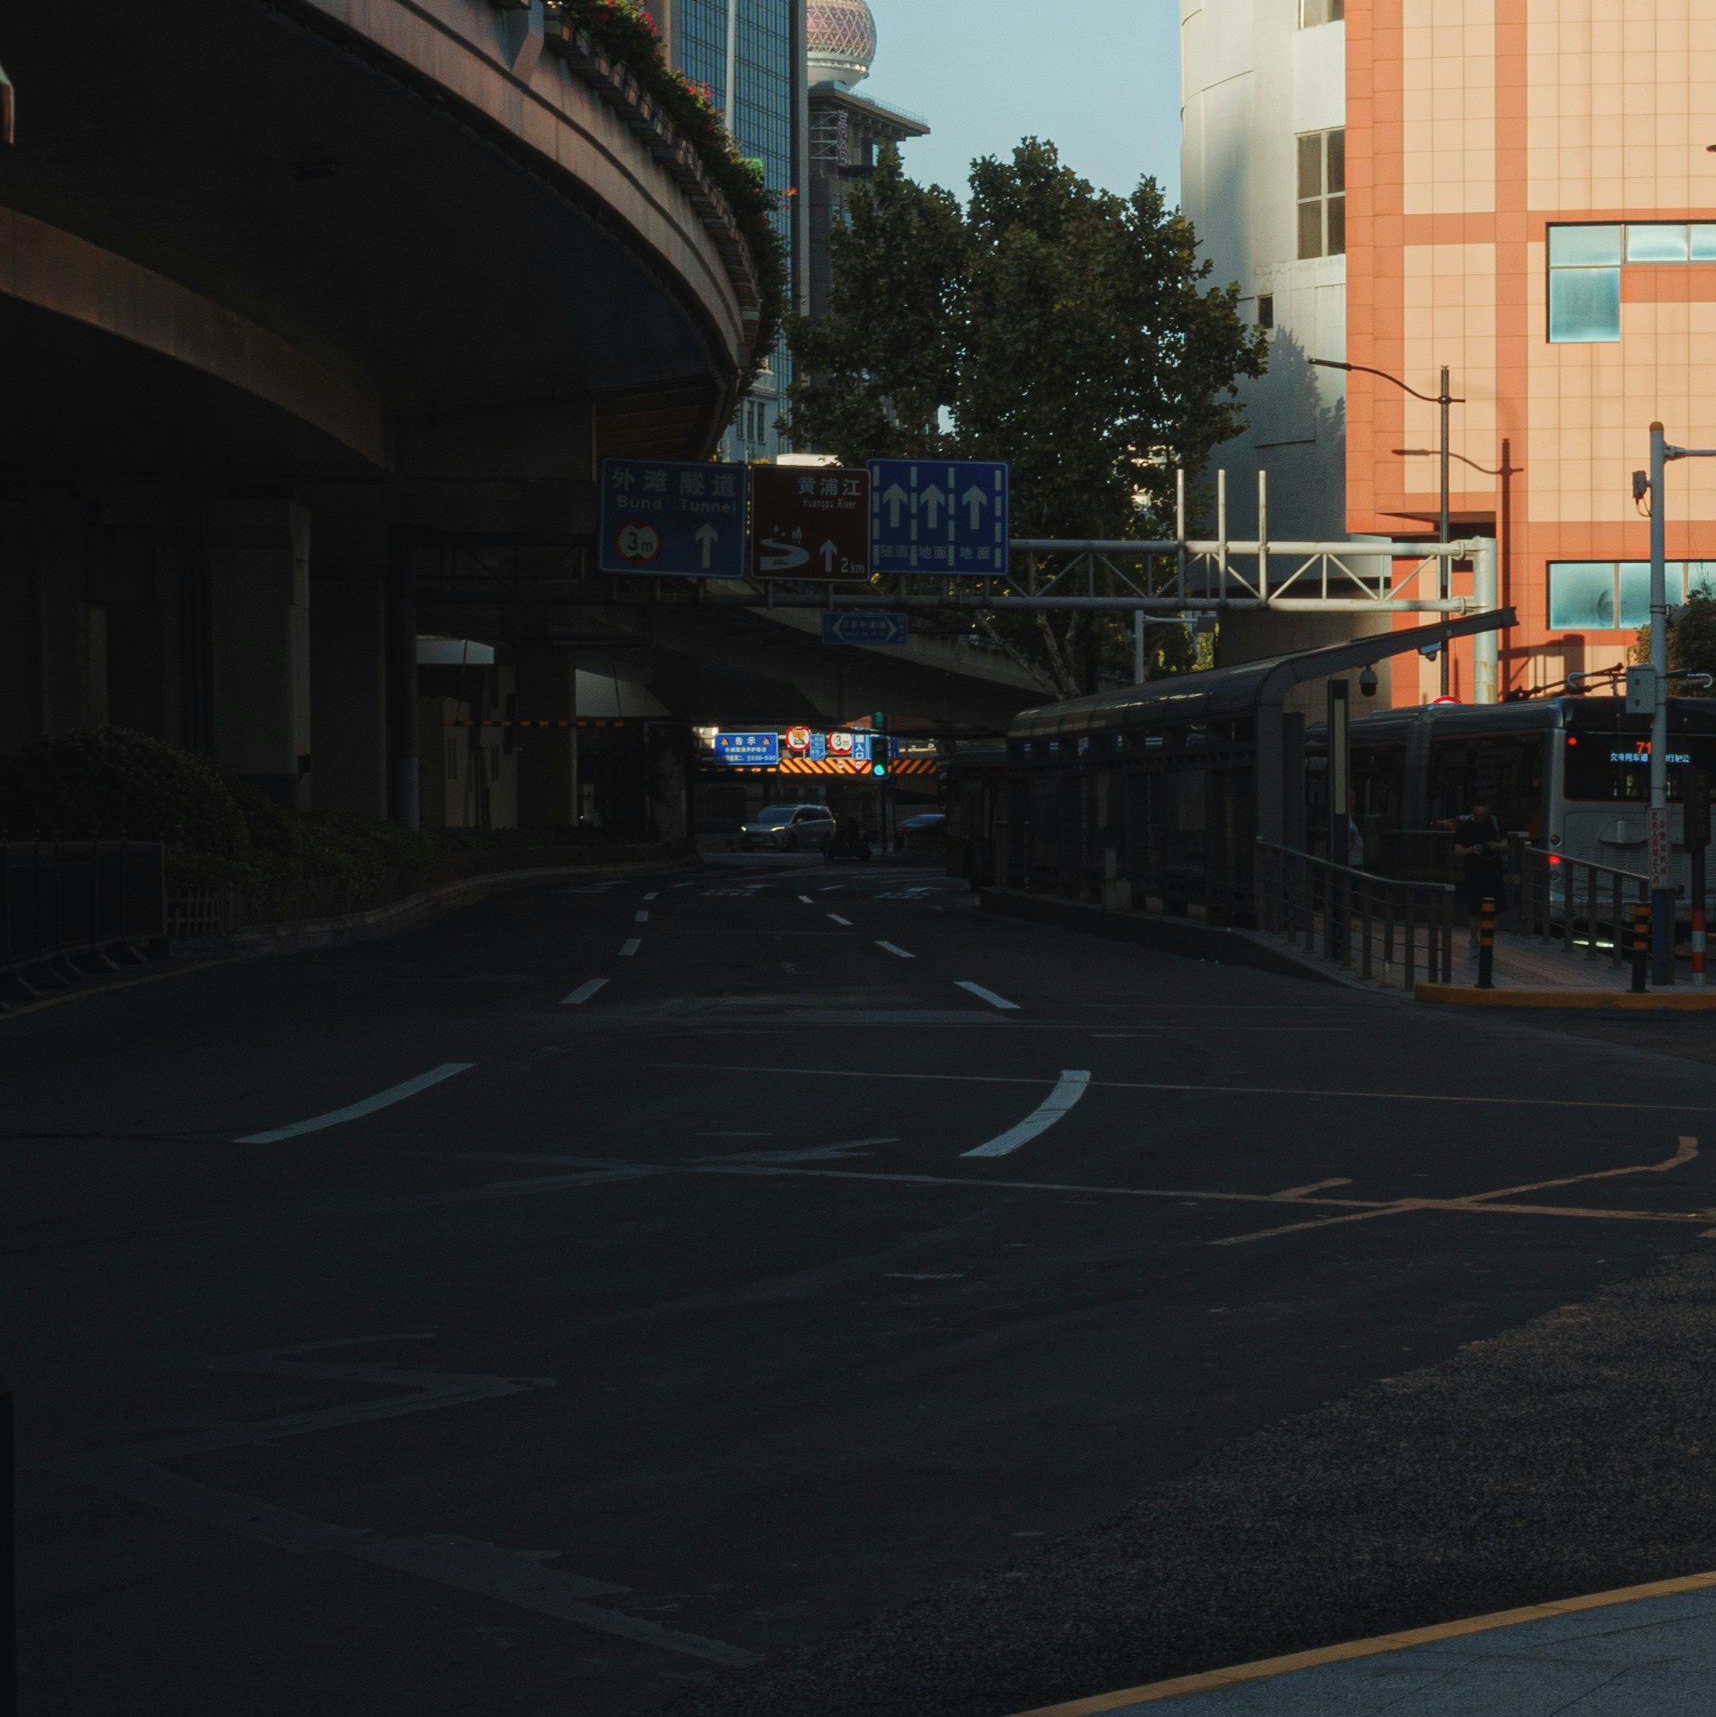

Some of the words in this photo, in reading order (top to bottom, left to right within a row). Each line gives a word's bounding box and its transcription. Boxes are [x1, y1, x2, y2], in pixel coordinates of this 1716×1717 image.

[611, 467, 737, 498] 外滩隧道
[797, 476, 862, 496] 黄浦江
[617, 495, 663, 510] Bund
[679, 498, 736, 514] Tunnel
[918, 545, 948, 559] 地面
[959, 546, 991, 560] 地面
